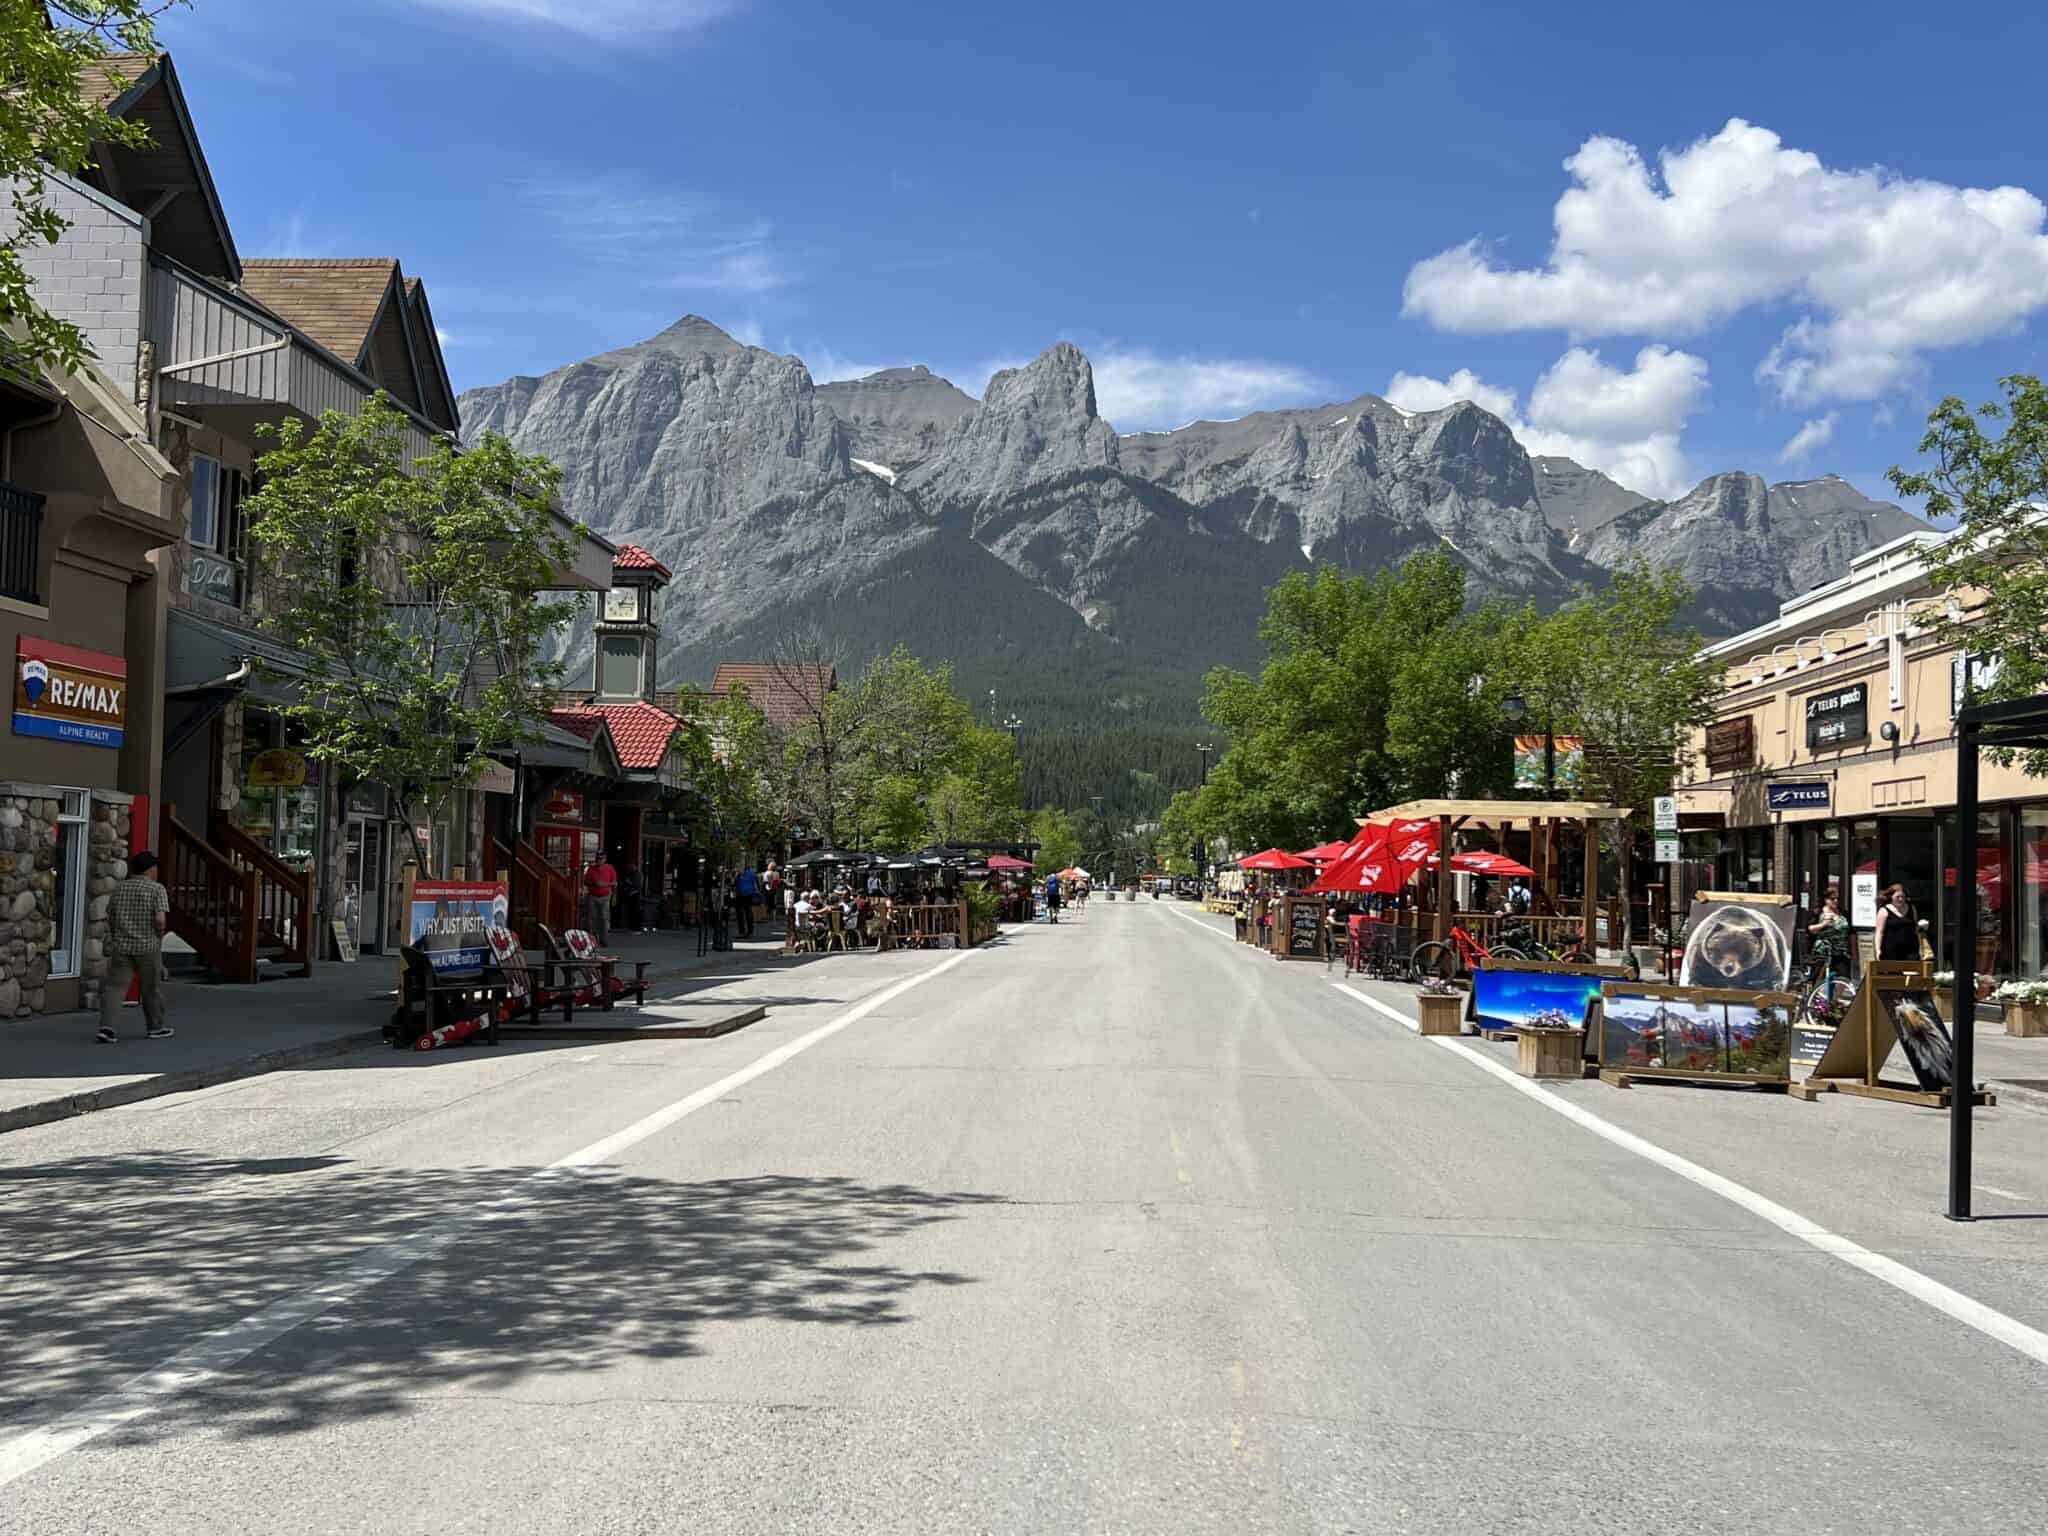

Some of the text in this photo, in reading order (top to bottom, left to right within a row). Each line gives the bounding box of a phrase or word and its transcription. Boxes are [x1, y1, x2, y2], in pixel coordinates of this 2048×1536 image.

[51, 677, 120, 715] RE/MAX
[1817, 696, 1839, 712] TELUS
[58, 725, 110, 741] ALPINE REALTY
[1792, 790, 1828, 800] TELUS
[418, 916, 486, 936] WHY JUST VISIT?
